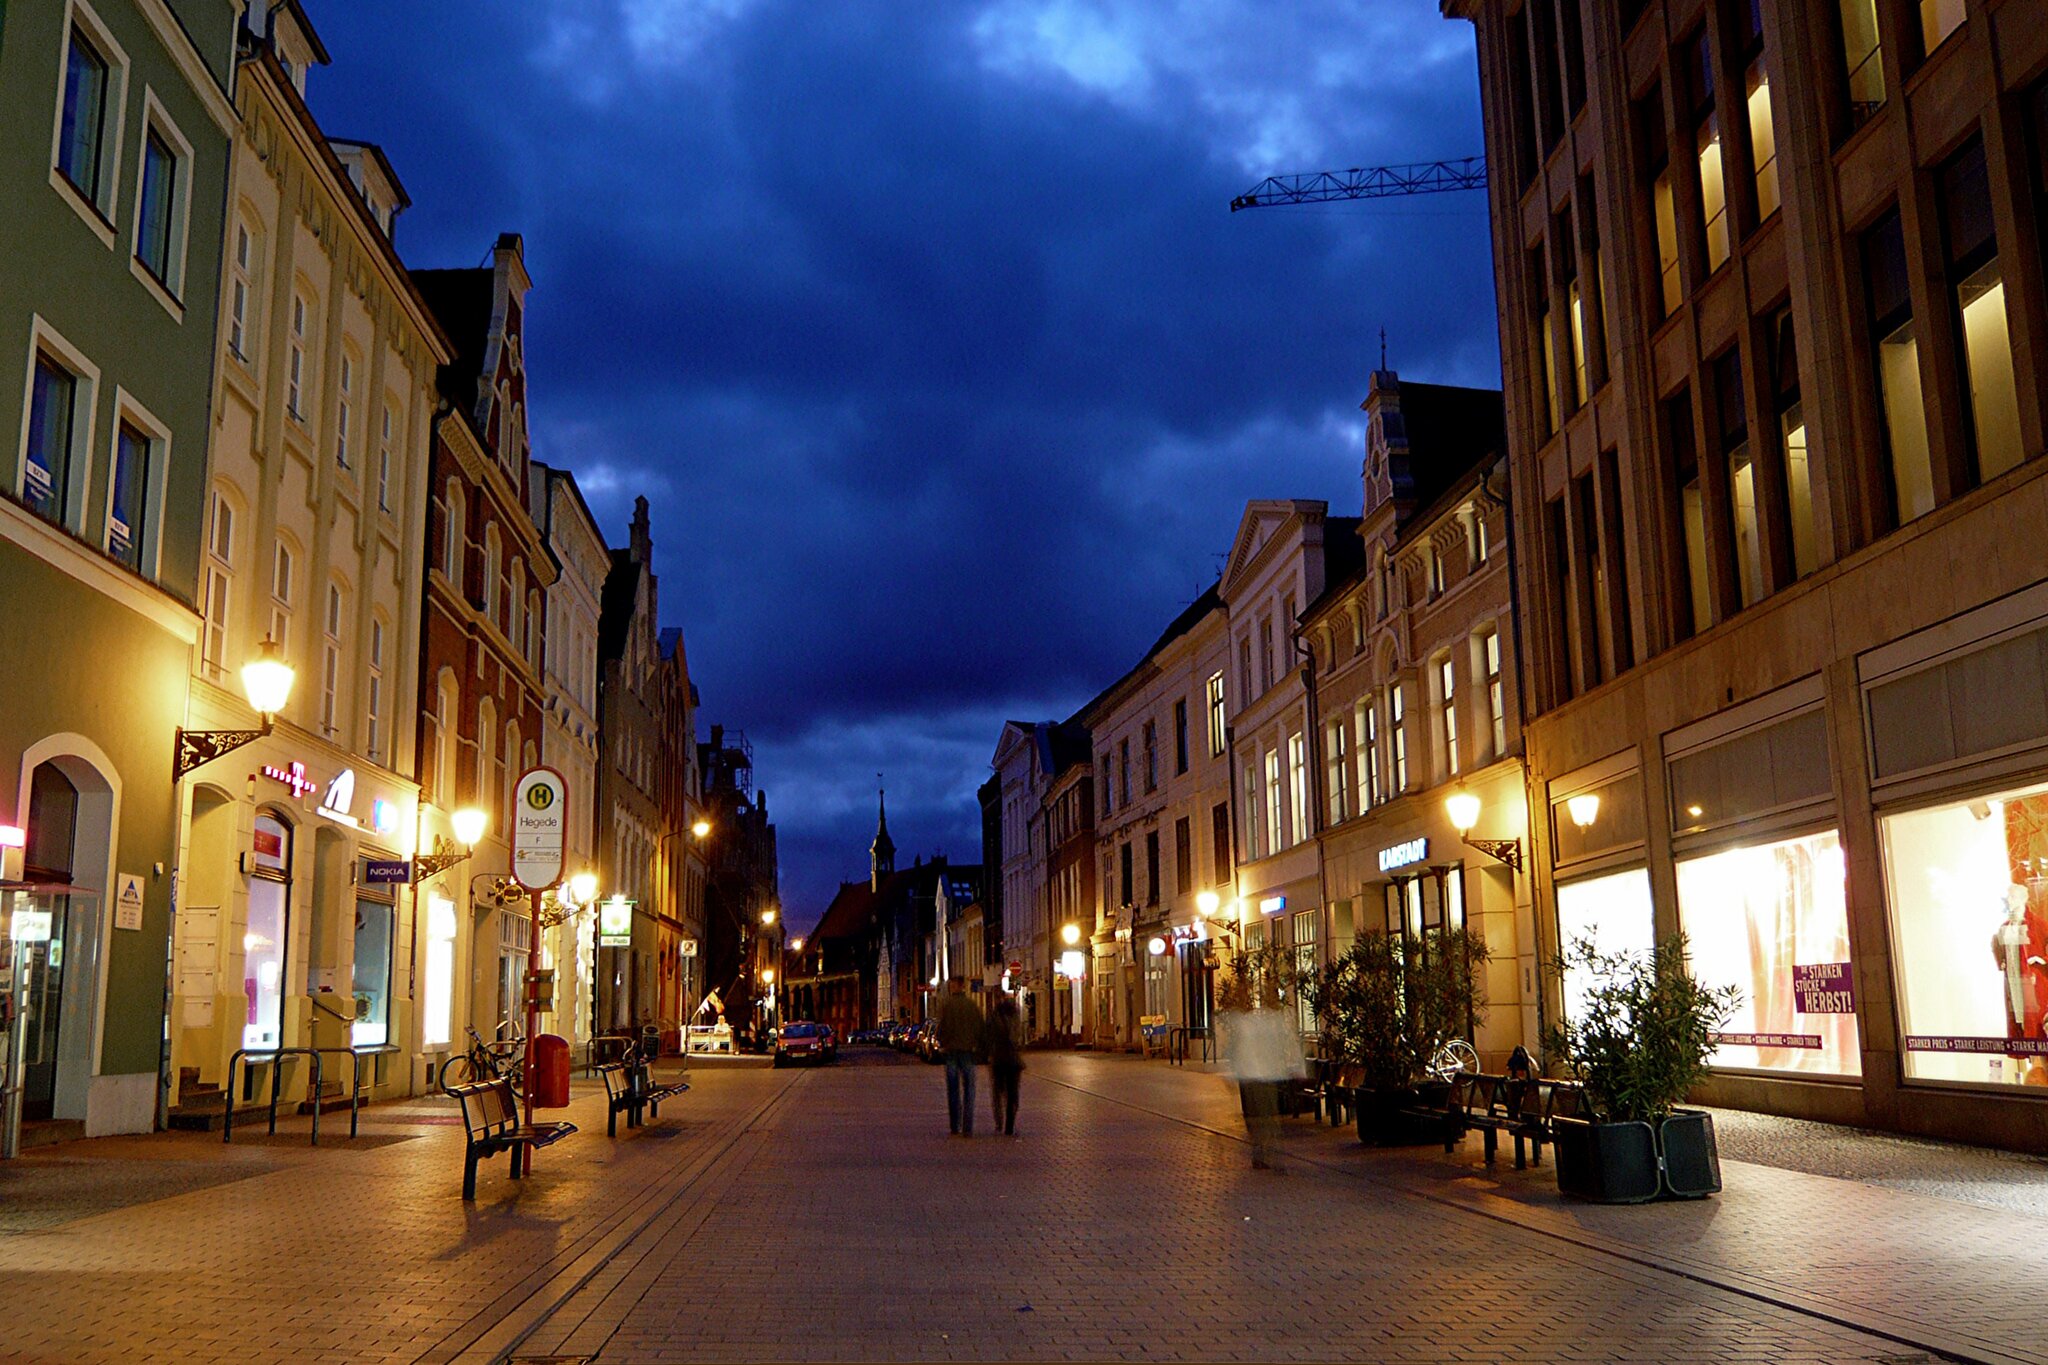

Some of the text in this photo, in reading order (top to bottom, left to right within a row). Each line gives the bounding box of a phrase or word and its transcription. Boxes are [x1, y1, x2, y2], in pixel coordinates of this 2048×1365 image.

[534, 789, 547, 804] H
[520, 816, 558, 829] Hegede
[535, 836, 541, 844] F
[369, 867, 405, 876] NOKIA
[1809, 964, 1843, 979] STARKEN
[1795, 977, 1820, 992] STÜCKE
[1804, 991, 1852, 1013] HERBST!
[1908, 1038, 1931, 1049] STARKER
[1932, 1038, 1948, 1049] PREIS
[1953, 1039, 1976, 1050] STARKE
[1976, 1039, 2005, 1051] LEISTUNG
[2012, 1040, 2037, 1051] STARKE
